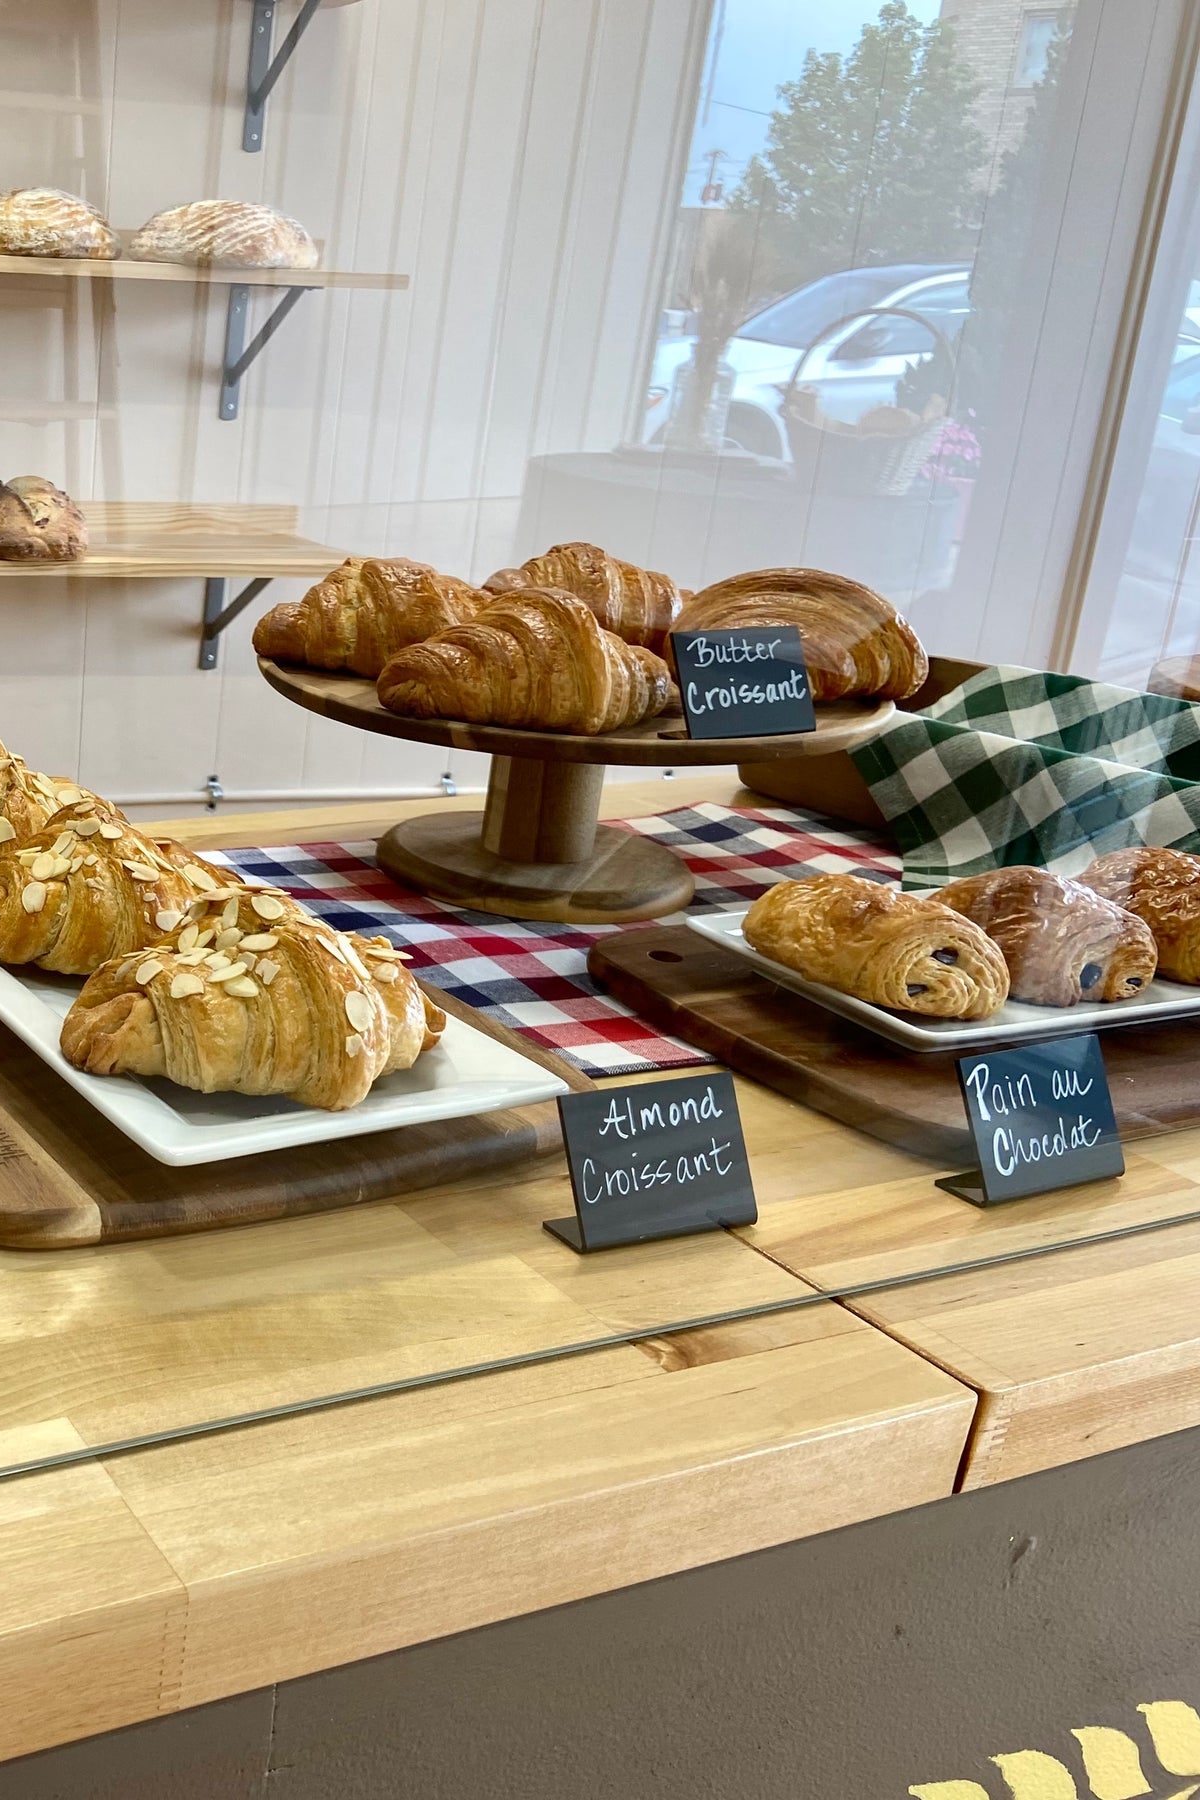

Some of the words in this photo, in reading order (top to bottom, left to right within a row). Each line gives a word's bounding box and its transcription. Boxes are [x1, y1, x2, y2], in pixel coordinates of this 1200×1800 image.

[686, 637, 782, 668] Butter
[687, 669, 807, 715] Croissant
[598, 1086, 724, 1140] Almond
[966, 1063, 1037, 1122] Pain
[1052, 1069, 1094, 1100] au
[582, 1137, 733, 1204] Croissant
